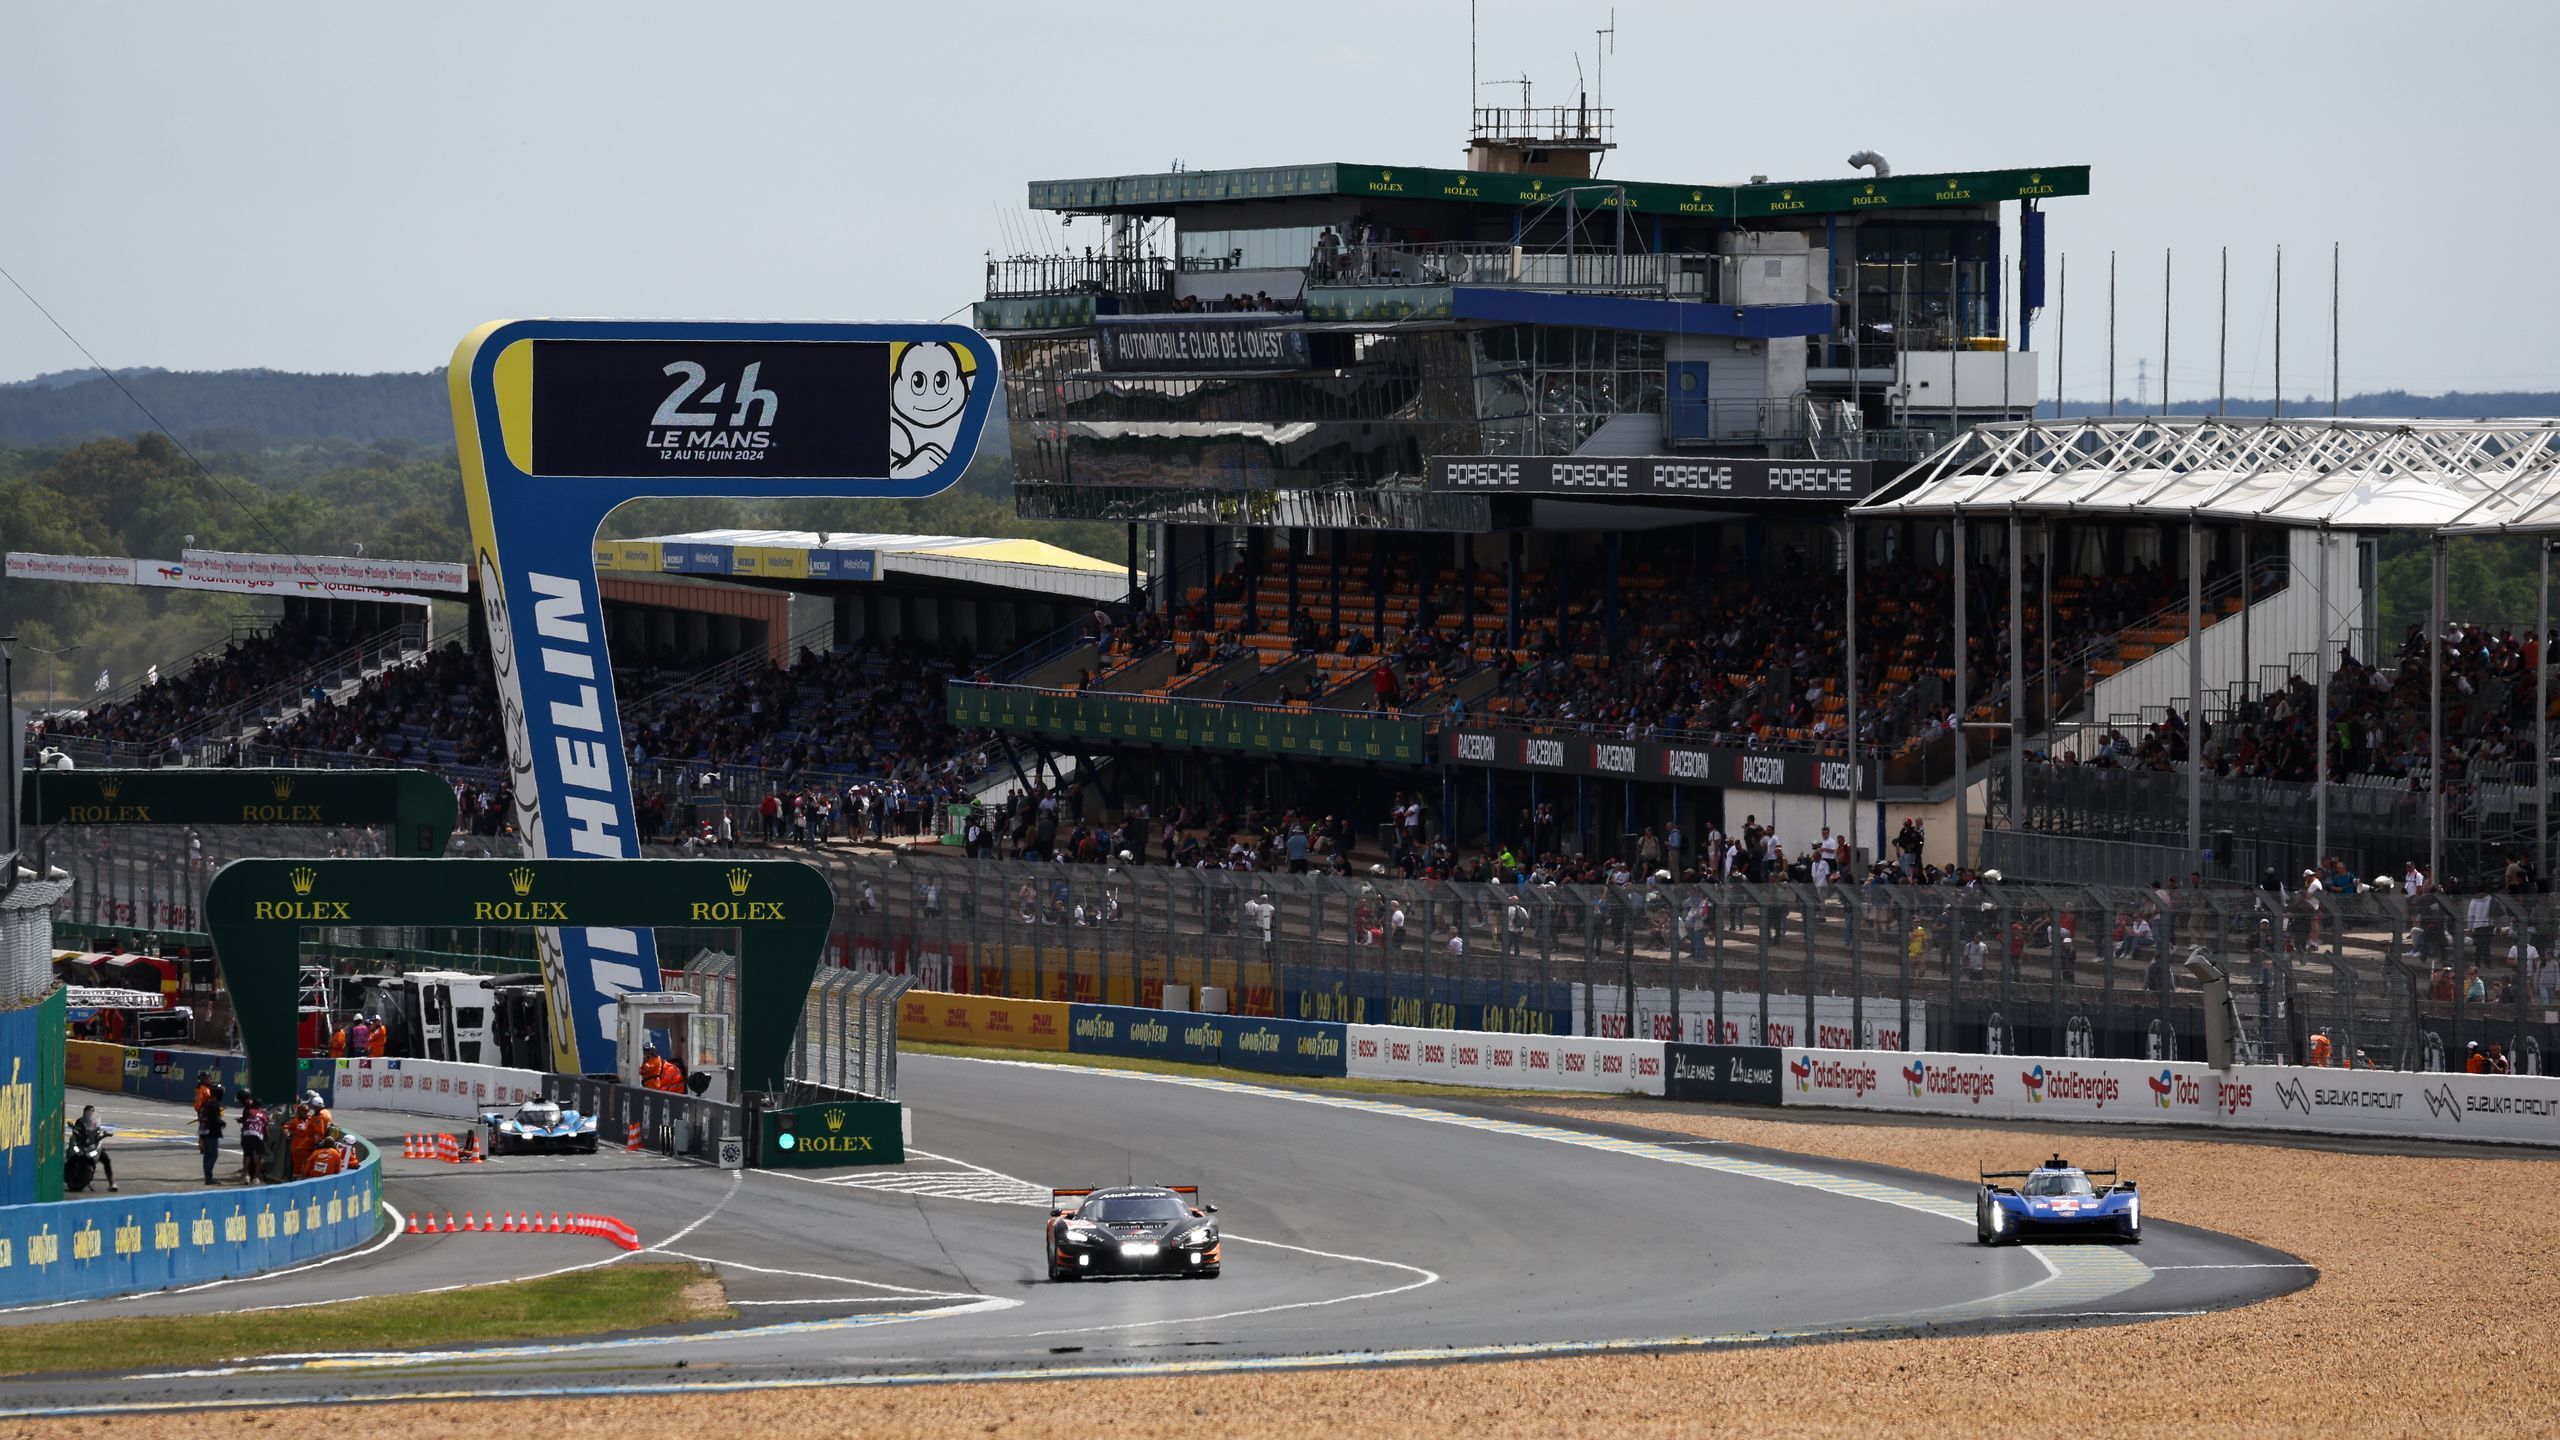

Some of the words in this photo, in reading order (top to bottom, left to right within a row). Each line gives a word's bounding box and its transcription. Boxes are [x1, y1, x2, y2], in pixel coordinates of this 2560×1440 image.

[1369, 182, 1404, 192] ROLEX
[1444, 187, 1479, 197] ROLEX
[1519, 191, 1554, 202] ROLEX
[1936, 190, 1971, 201] ROLEX
[2019, 184, 2054, 195] ROLEX
[1603, 197, 1638, 208] ROEX
[1680, 203, 1714, 212] ROLEX
[1771, 201, 1805, 210] ROLEX
[1853, 196, 1887, 205] ROLEX
[1119, 333, 1189, 360] AUTOMOBILE
[1190, 332, 1219, 359] CLUB
[1220, 332, 1237, 359] DE
[1238, 331, 1284, 359] L'OUEST
[650, 360, 778, 427] 24h
[646, 430, 682, 448] LE
[687, 430, 770, 448] MANS
[660, 450, 672, 460] 12
[674, 450, 691, 460] AU
[694, 450, 705, 460] 16
[707, 450, 733, 462] JUIN
[735, 450, 764, 460] 2024
[1447, 463, 1519, 485] PORSCHE
[1552, 463, 1628, 488] PORSCHE
[1654, 465, 1732, 490] PORSCHE
[1768, 467, 1852, 492] PORSCHE
[1458, 734, 1495, 761] RACEBORN
[1526, 739, 1563, 767] RACEBORN
[1596, 744, 1635, 773] RACEBORN
[1669, 750, 1709, 779] RACEBORN
[1742, 756, 1785, 785] RACEBORN
[1820, 762, 1863, 791] RACEBON
[69, 805, 151, 822] ROLEX
[242, 805, 321, 821] ROLEX
[254, 901, 350, 920] ROLEX
[474, 901, 568, 920] ROLEX
[691, 902, 786, 921] ROLEX
[1076, 1014, 1115, 1040] GOODYEAR
[1131, 1018, 1168, 1046] GOODYEAR
[1185, 1022, 1222, 1050] GOODYEAR
[1654, 1014, 1684, 1042] BOSH
[1708, 1018, 1738, 1044] BSCH
[1767, 1022, 1794, 1048] OSCH
[1239, 1026, 1280, 1055] GOODYEAR
[1297, 1030, 1339, 1061] GOODYEAR
[1358, 1039, 1377, 1057] BOSCH
[1392, 1043, 1410, 1061] BOSCH
[1425, 1045, 1444, 1063] BOSCH
[1459, 1047, 1478, 1065] BOSCH
[1493, 1049, 1512, 1067] BOSCH
[1530, 1051, 1549, 1069] BOSCH
[127, 1060, 139, 1068] 19
[1565, 1053, 1585, 1072] BOSCH
[1603, 1055, 1622, 1073] BOSCH
[1638, 1057, 1659, 1075] BOSCH
[1687, 1064, 1695, 1080] LE
[1695, 1065, 1715, 1081] MANS
[1744, 1068, 1752, 1083] LE
[1753, 1068, 1773, 1084] MANS
[1812, 1061, 1876, 1098] TotalEnergies
[1925, 1065, 1994, 1104] TotalEnergies
[2046, 1070, 2118, 1108] TotalEnergies
[2175, 1074, 2252, 1115] Totaergies
[2315, 1088, 2359, 1107] SUZUKA
[2361, 1091, 2403, 1109] CIRCUIT
[2466, 1095, 2511, 1114] SUZUKA
[2515, 1098, 2558, 1117] CIRCUIT
[798, 1136, 874, 1152] ROLEX
